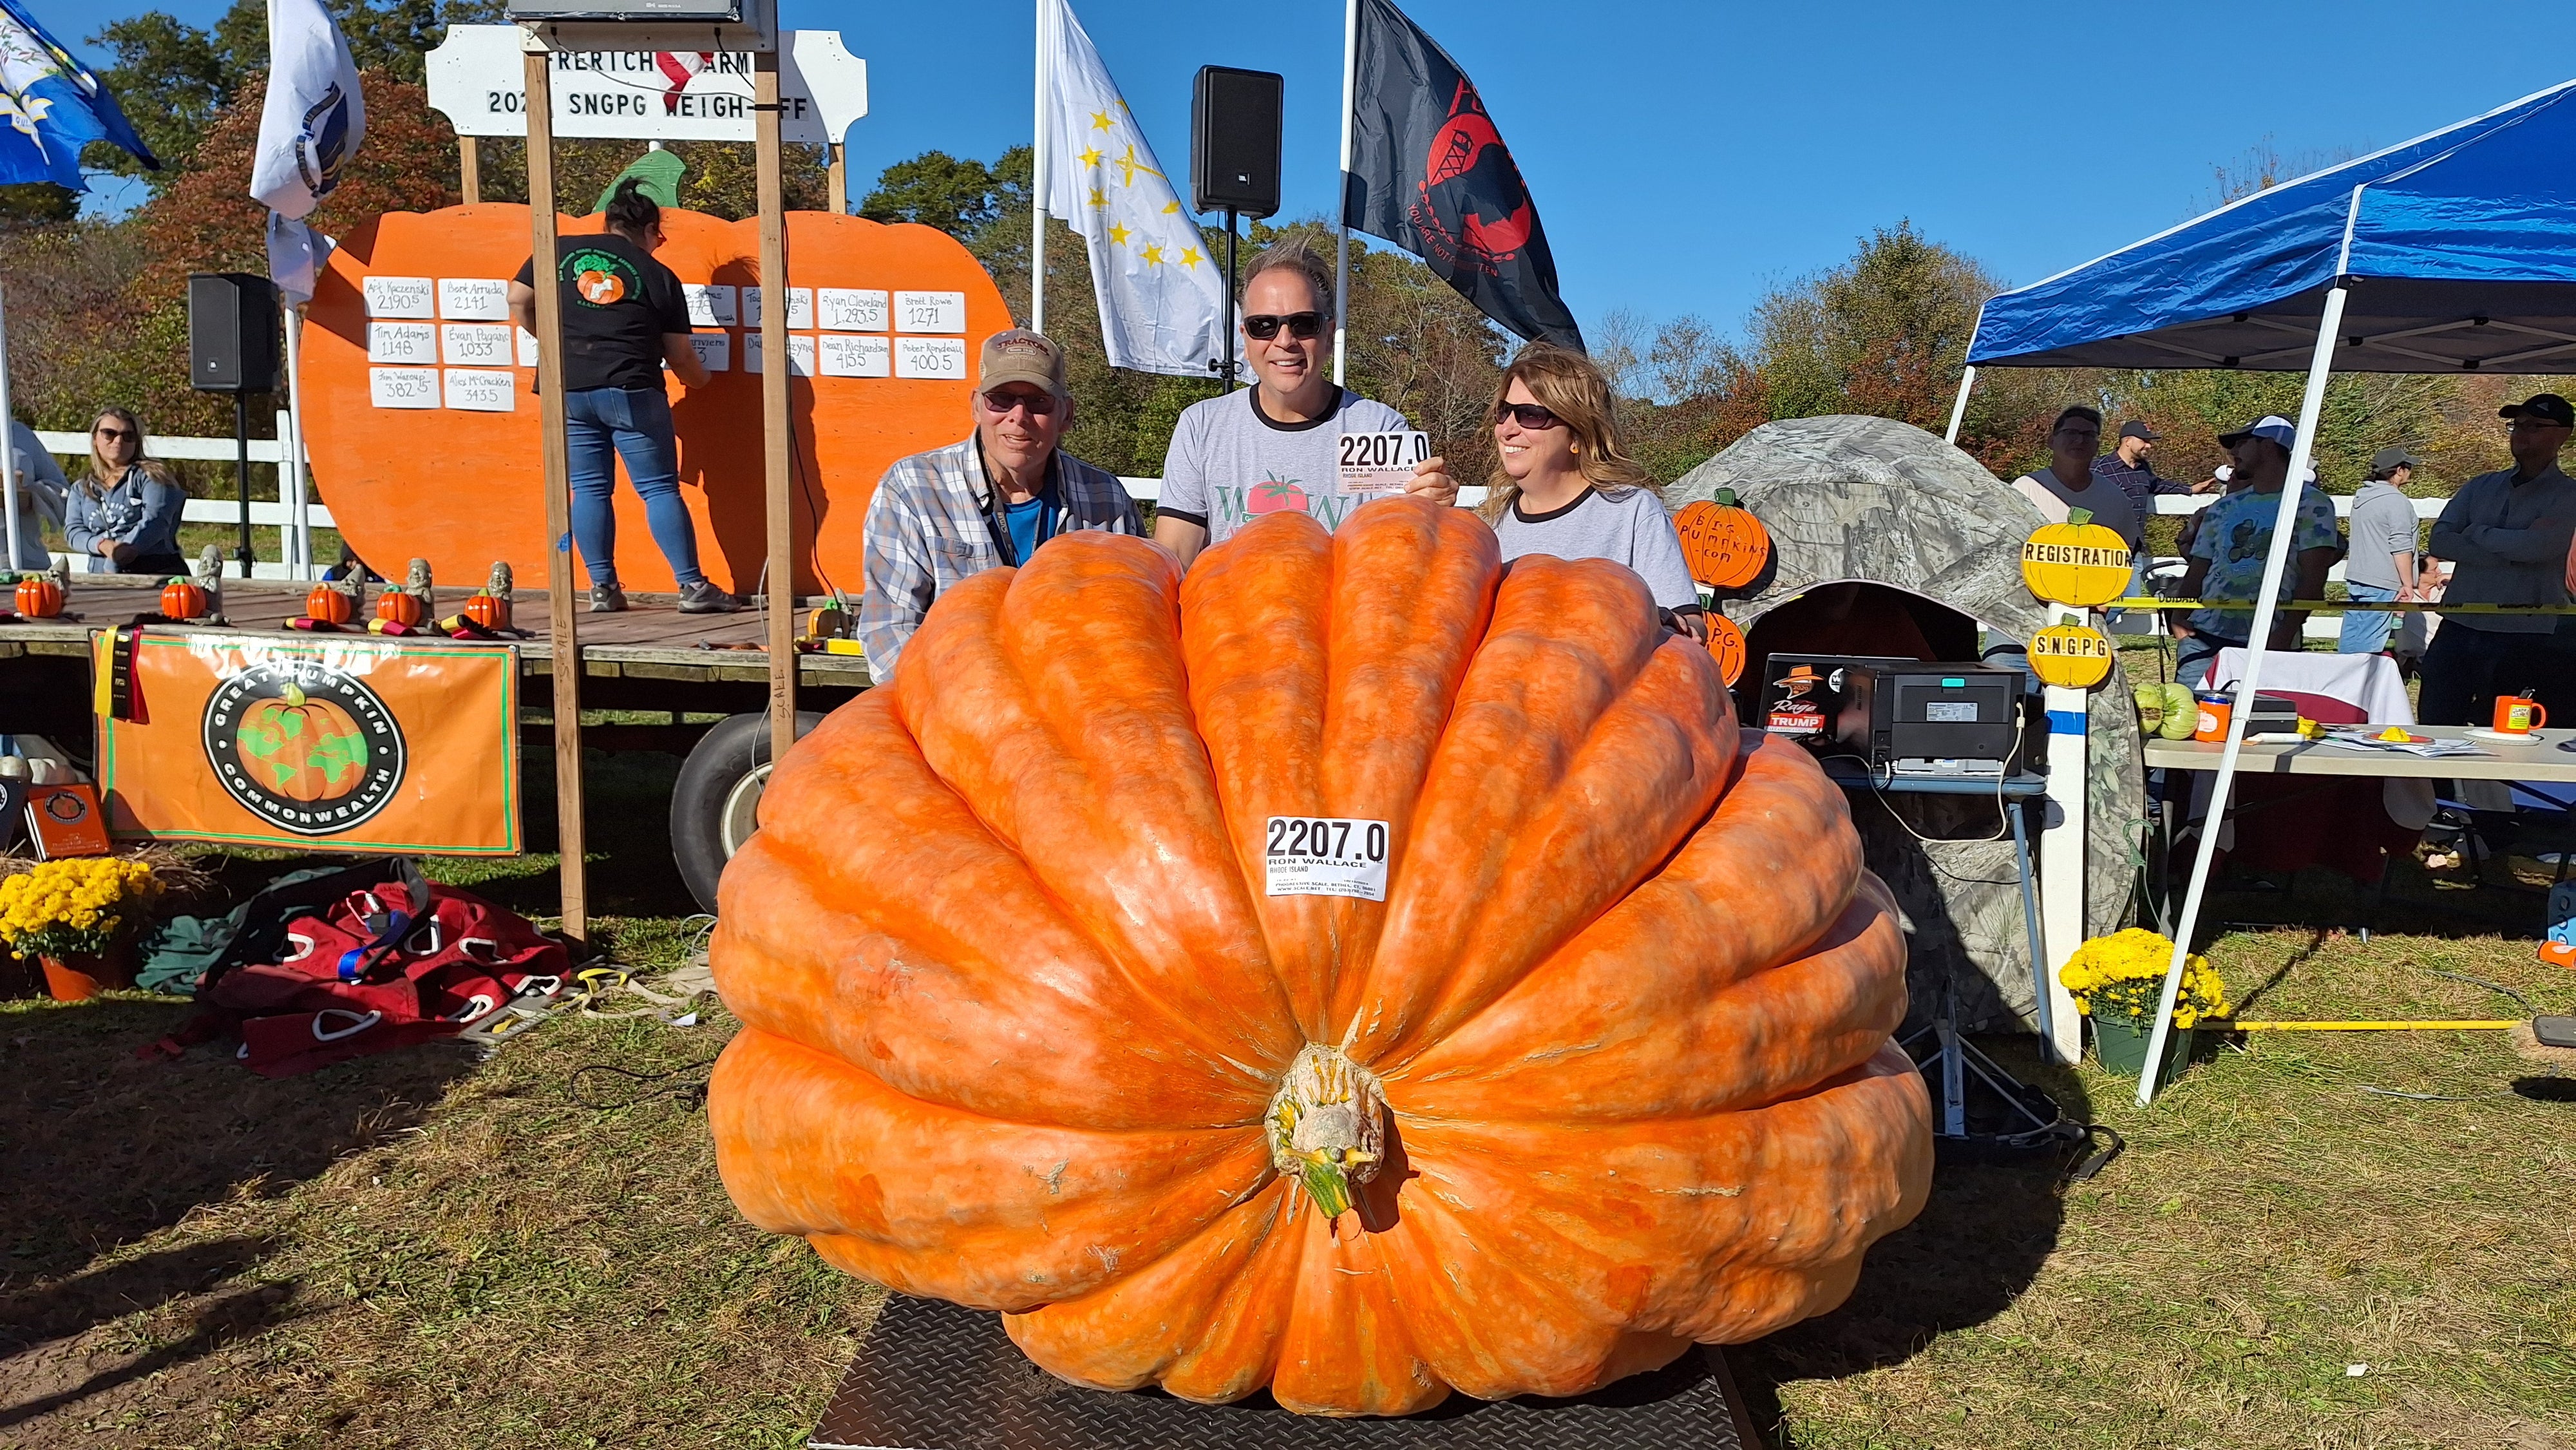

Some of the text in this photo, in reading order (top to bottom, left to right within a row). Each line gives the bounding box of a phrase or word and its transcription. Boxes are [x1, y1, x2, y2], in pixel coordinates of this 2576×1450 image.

[569, 93, 646, 115] SNGPG
[1408, 203, 1423, 224] YOU
[1418, 225, 1435, 244] ARE
[1433, 243, 1450, 260] NOT
[848, 294, 887, 308] Cleveland
[909, 307, 940, 327] 1271
[394, 327, 430, 341] Adams
[903, 343, 925, 352] Peter
[997, 338, 1049, 356] TRACTOR
[1340, 434, 1428, 466] 2207.0
[2025, 543, 2132, 568] REGISTRATION
[214, 668, 388, 735] GREAT PUMPKIN
[1771, 700, 1817, 714] Rage
[1771, 717, 1819, 727] TRUMP
[223, 763, 390, 824] COMMONWEALTH
[1267, 819, 1385, 861] 2207.0
[1302, 858, 1367, 868] WALLACE
